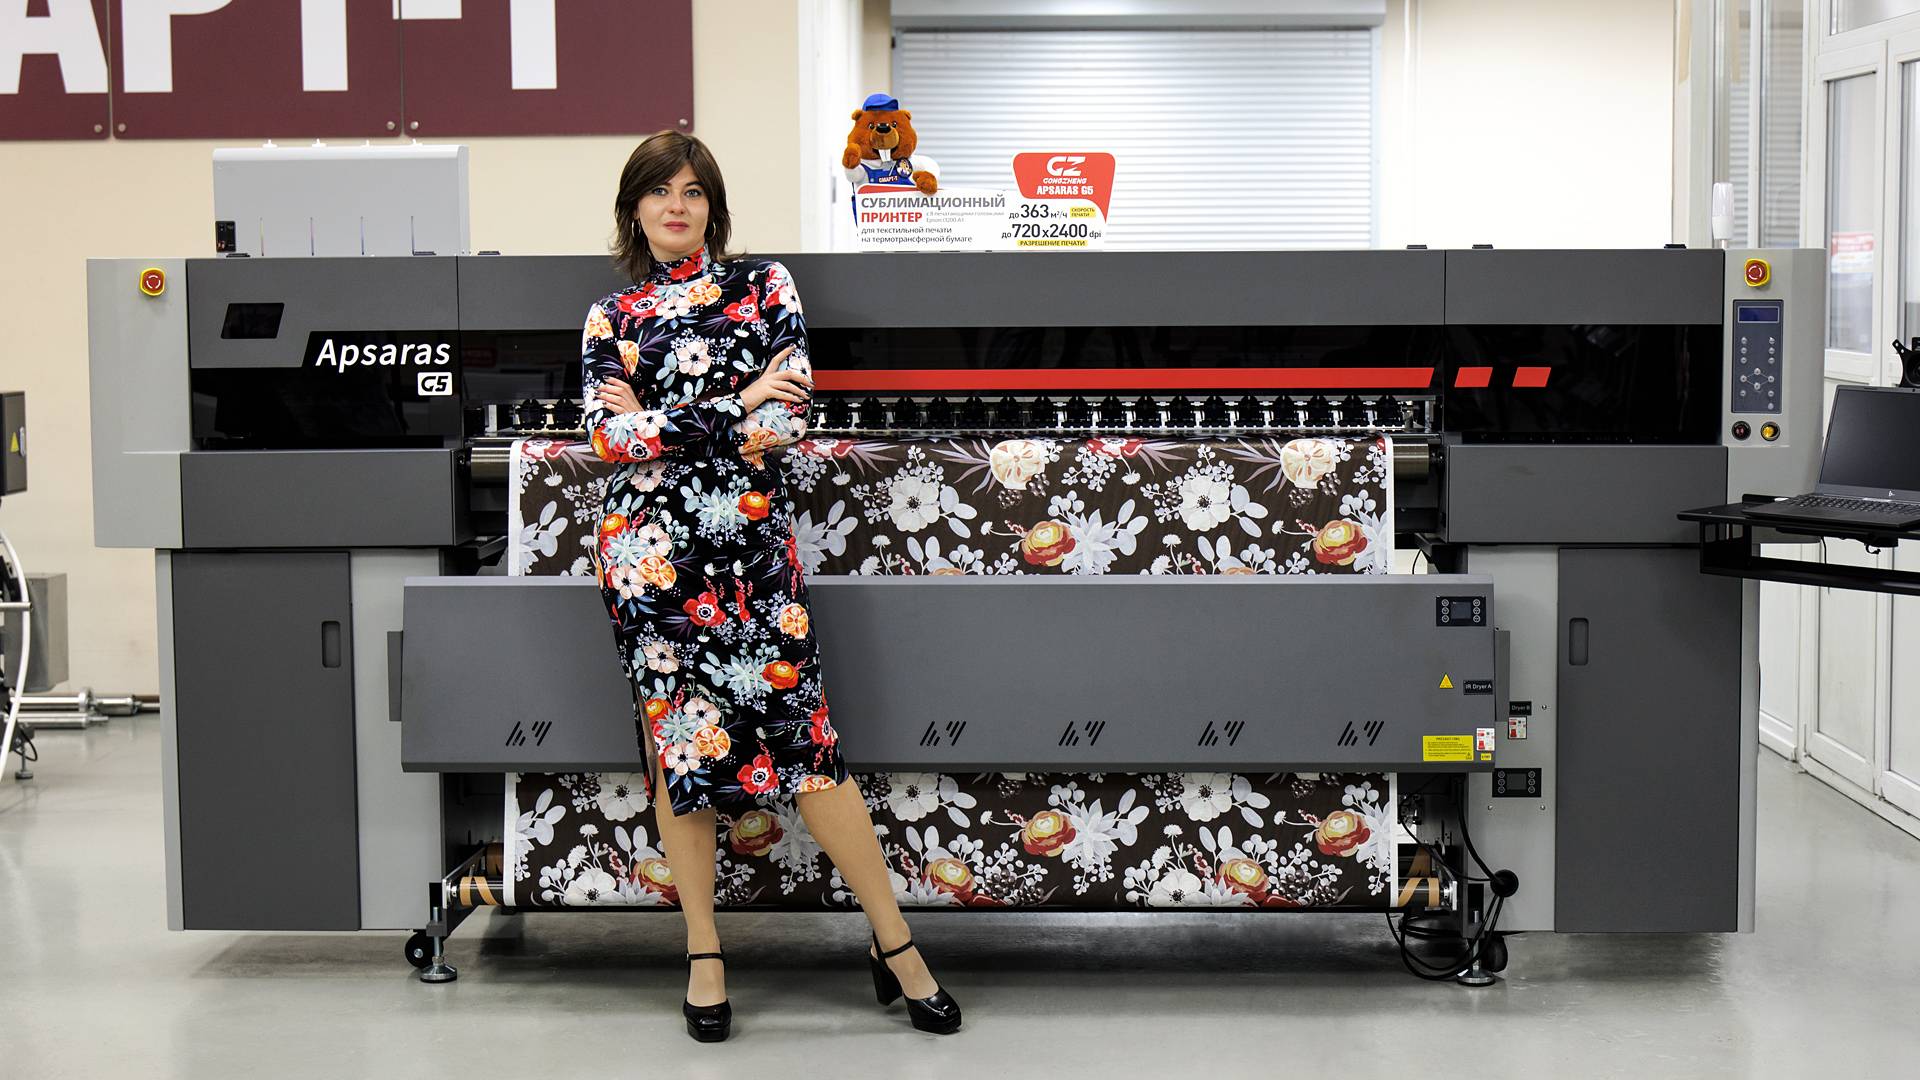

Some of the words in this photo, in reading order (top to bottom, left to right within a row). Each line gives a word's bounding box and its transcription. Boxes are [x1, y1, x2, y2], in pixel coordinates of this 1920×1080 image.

[1036, 185, 1078, 195] APSARAS
[1081, 185, 1094, 195] G5
[861, 194, 1005, 210] СУБЛИМАЦИОННЫЙ
[1020, 204, 1049, 218] 363
[861, 212, 923, 223] ПРИНТЕР
[876, 226, 924, 234] текстильной
[1089, 230, 1102, 240] dpi
[872, 235, 945, 244] термотрансферной
[946, 236, 973, 244] бумаге
[315, 338, 451, 373] Apsaras
[421, 375, 449, 392] G5
